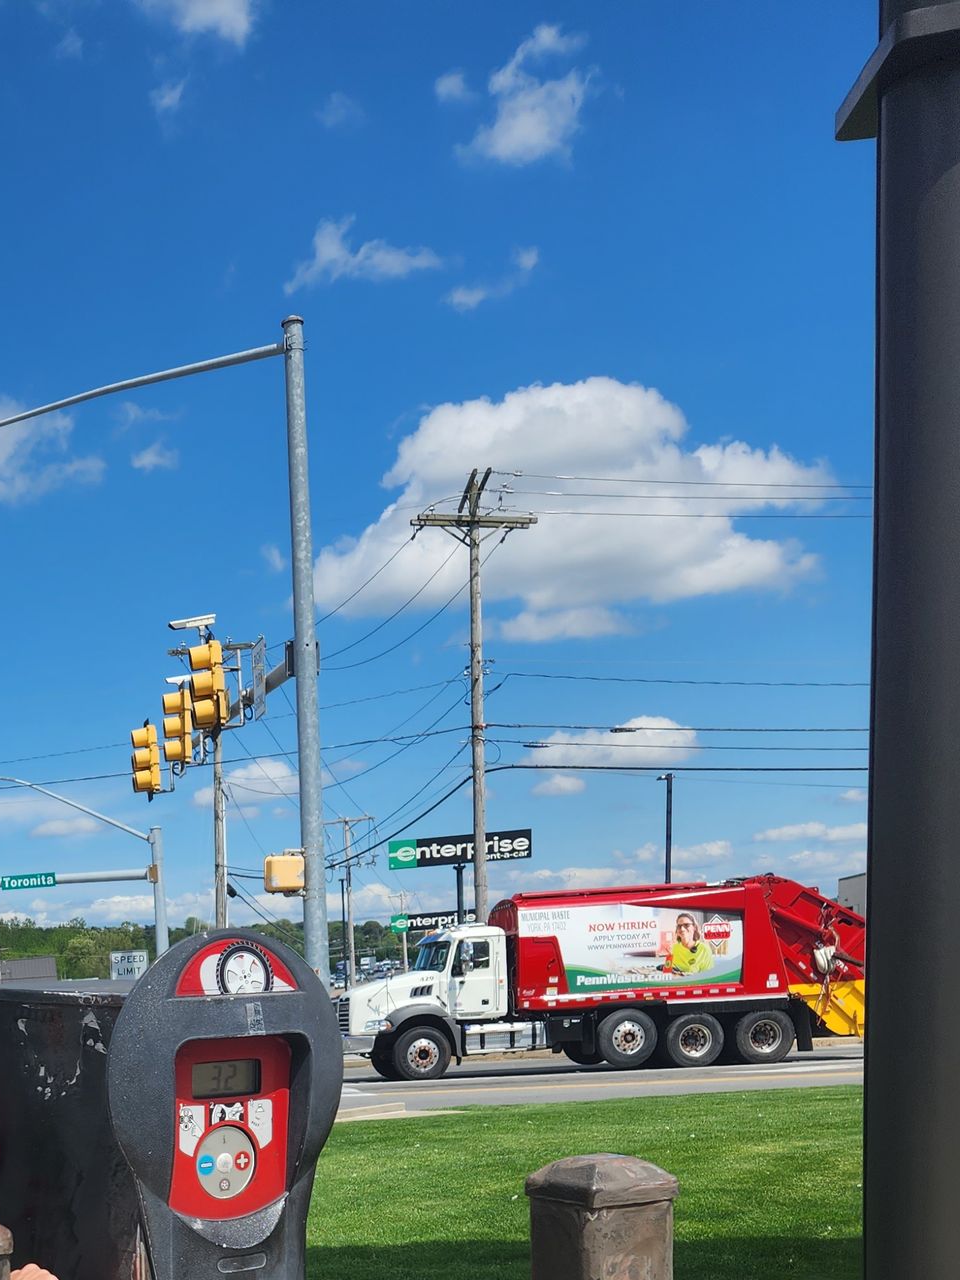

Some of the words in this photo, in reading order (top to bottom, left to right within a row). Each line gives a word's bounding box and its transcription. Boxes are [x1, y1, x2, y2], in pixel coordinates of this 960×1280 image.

[486, 850, 529, 860] ent-a-car
[2, 874, 54, 888] Toronita
[391, 913, 476, 929] enterprie
[521, 911, 550, 921] MUNICIPAL
[552, 910, 570, 920] WASTE
[588, 922, 615, 932] NOW
[618, 920, 657, 930] HIRING
[593, 934, 615, 942] APPLY
[616, 933, 641, 941] TODAY
[587, 941, 657, 951] WWW.PENNWASTE.COM
[114, 954, 145, 964] SPEED
[117, 966, 141, 976] LIMIT
[576, 972, 673, 986] PennWaste.com
[209, 1063, 238, 1092] 32
